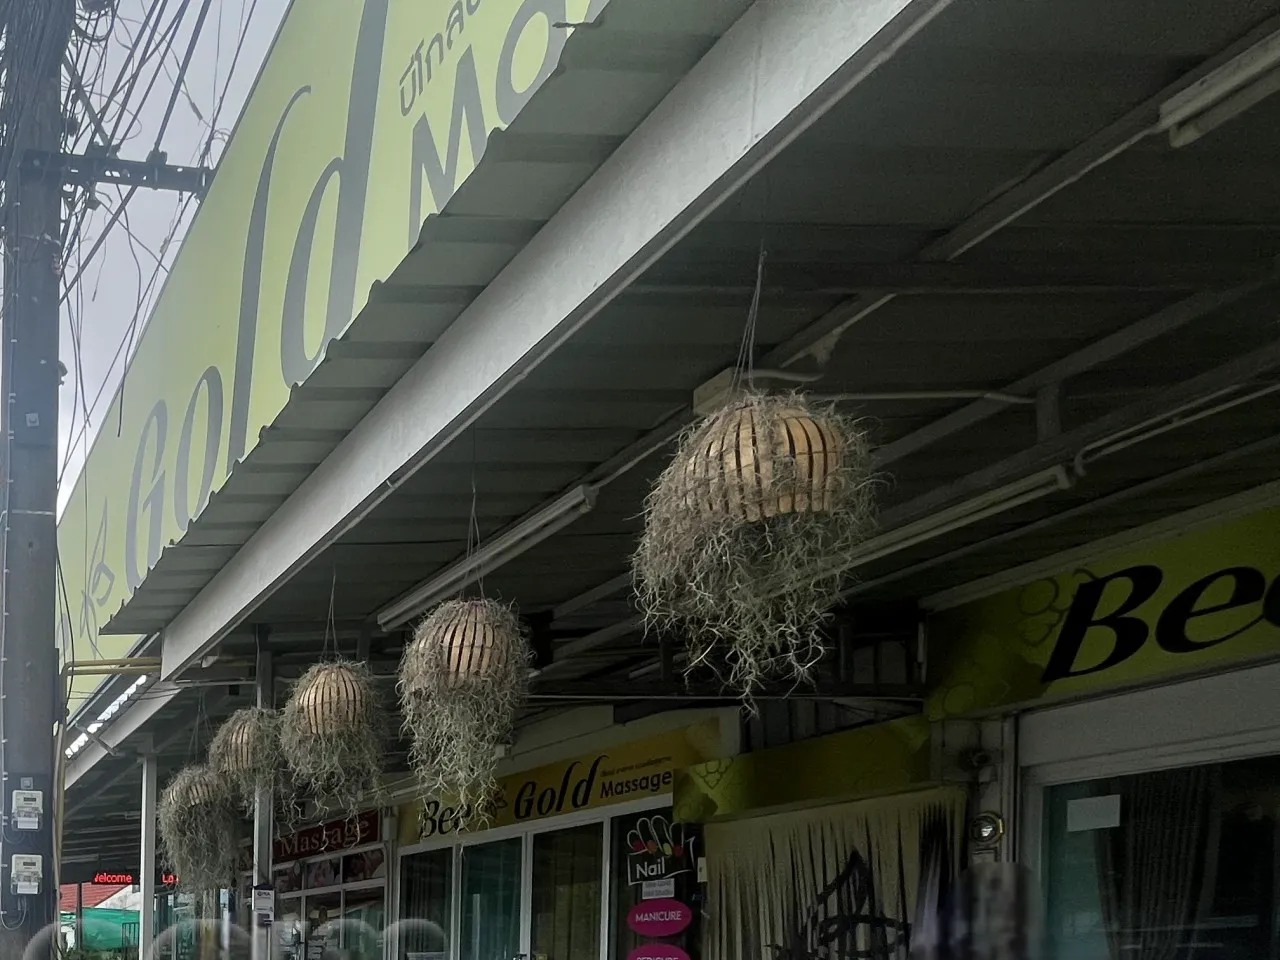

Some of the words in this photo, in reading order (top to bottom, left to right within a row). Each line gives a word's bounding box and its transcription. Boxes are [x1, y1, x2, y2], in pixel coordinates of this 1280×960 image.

[1041, 564, 1280, 684] Be
[514, 755, 609, 820] Gold
[600, 770, 673, 799] Massage
[636, 856, 666, 879] Nail
[635, 910, 682, 923] MANICURE
